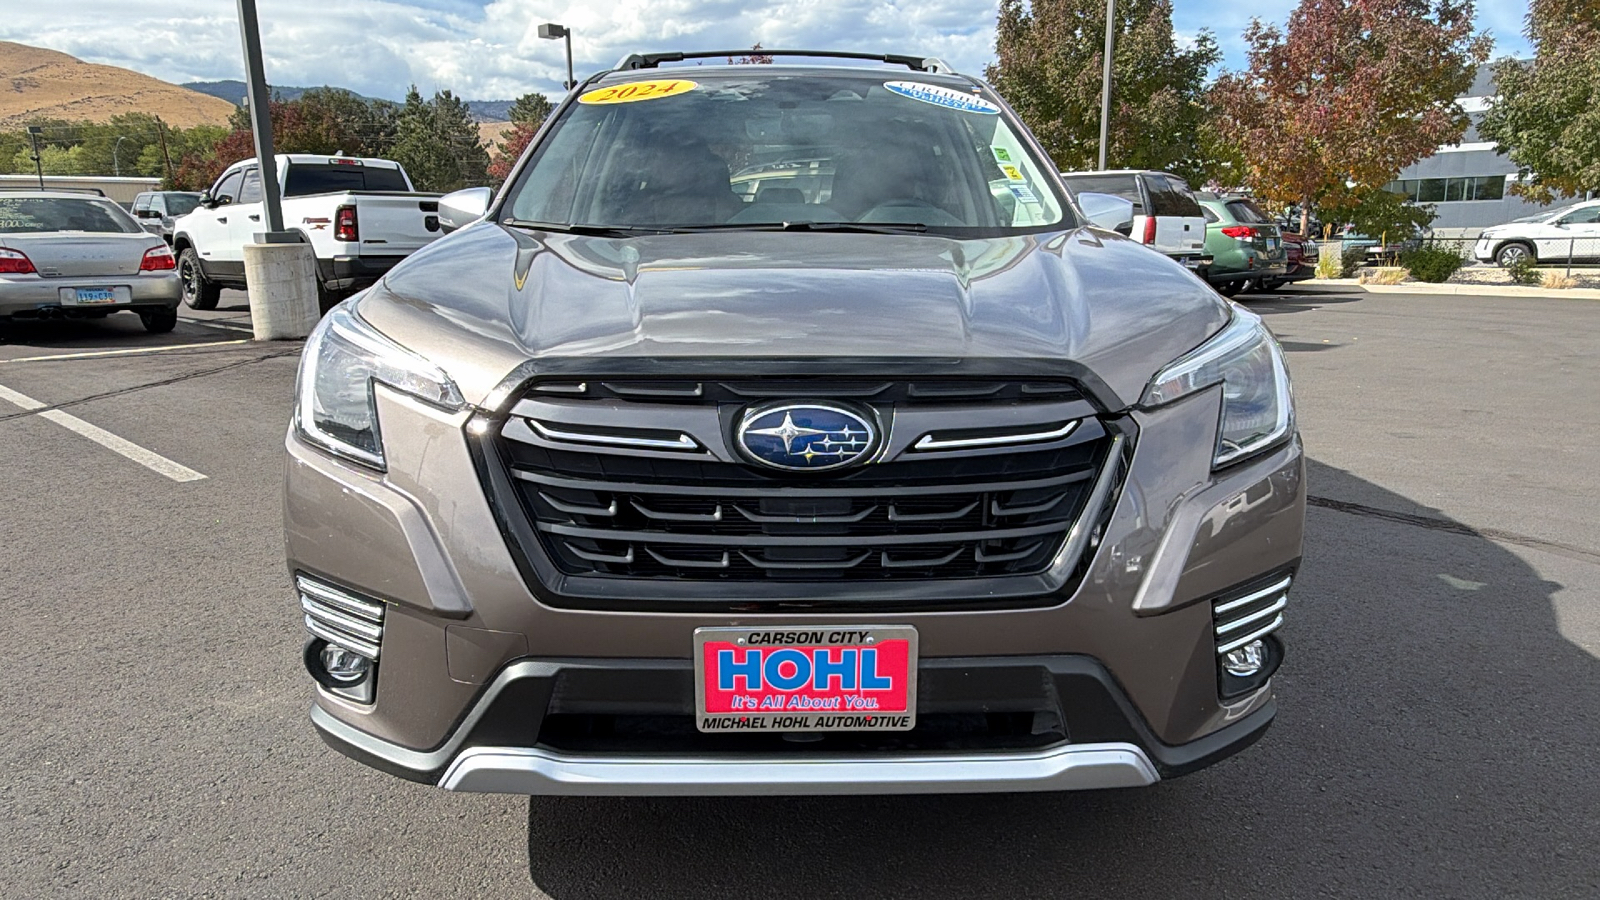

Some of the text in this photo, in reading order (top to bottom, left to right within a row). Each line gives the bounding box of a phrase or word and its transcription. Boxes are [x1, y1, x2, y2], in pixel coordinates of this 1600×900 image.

[597, 82, 679, 102] 2024
[748, 631, 869, 645] CARSON CITY
[718, 648, 892, 691] HOHL
[732, 695, 879, 709] It's All About You.
[702, 716, 910, 729] MICHAEL HOHL AUTOMOTIVE
